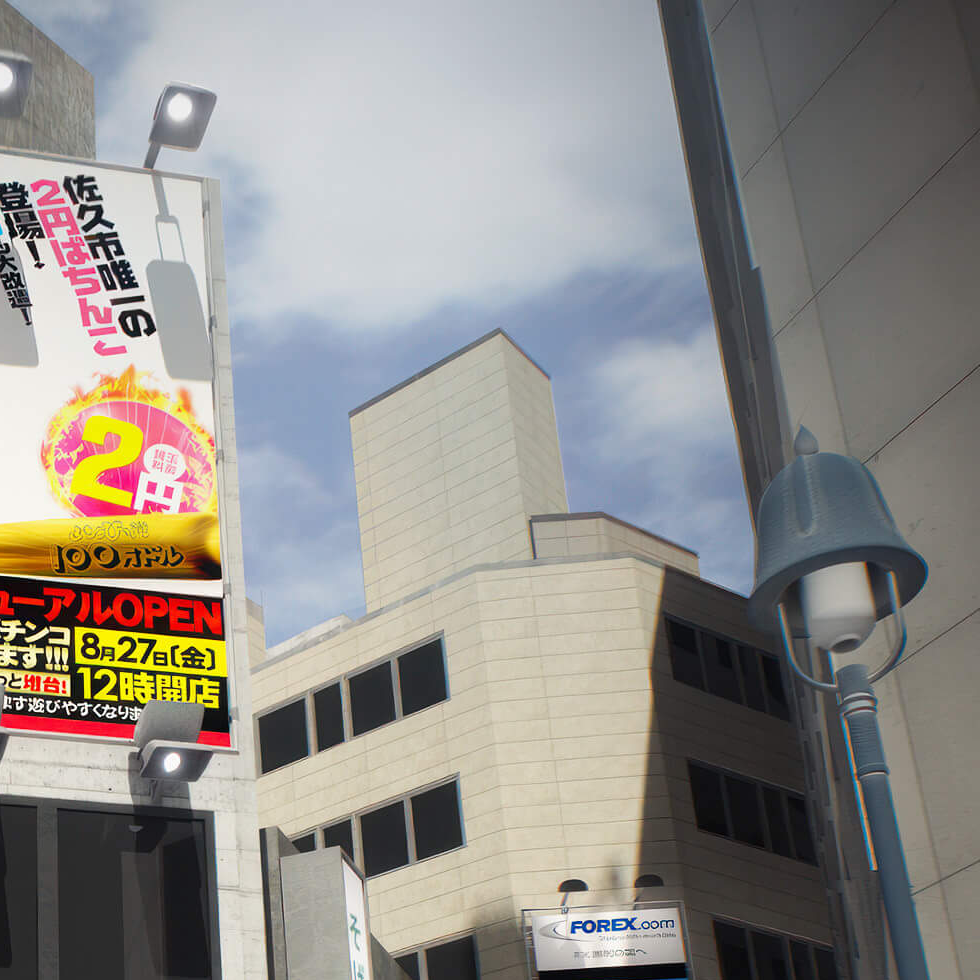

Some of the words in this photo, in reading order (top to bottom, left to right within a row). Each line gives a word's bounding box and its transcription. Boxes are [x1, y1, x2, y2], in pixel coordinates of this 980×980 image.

[63, 174, 157, 338] 佐久市唯一の
[76, 667, 220, 709] 12時開店
[570, 917, 676, 935] FOREX.com
